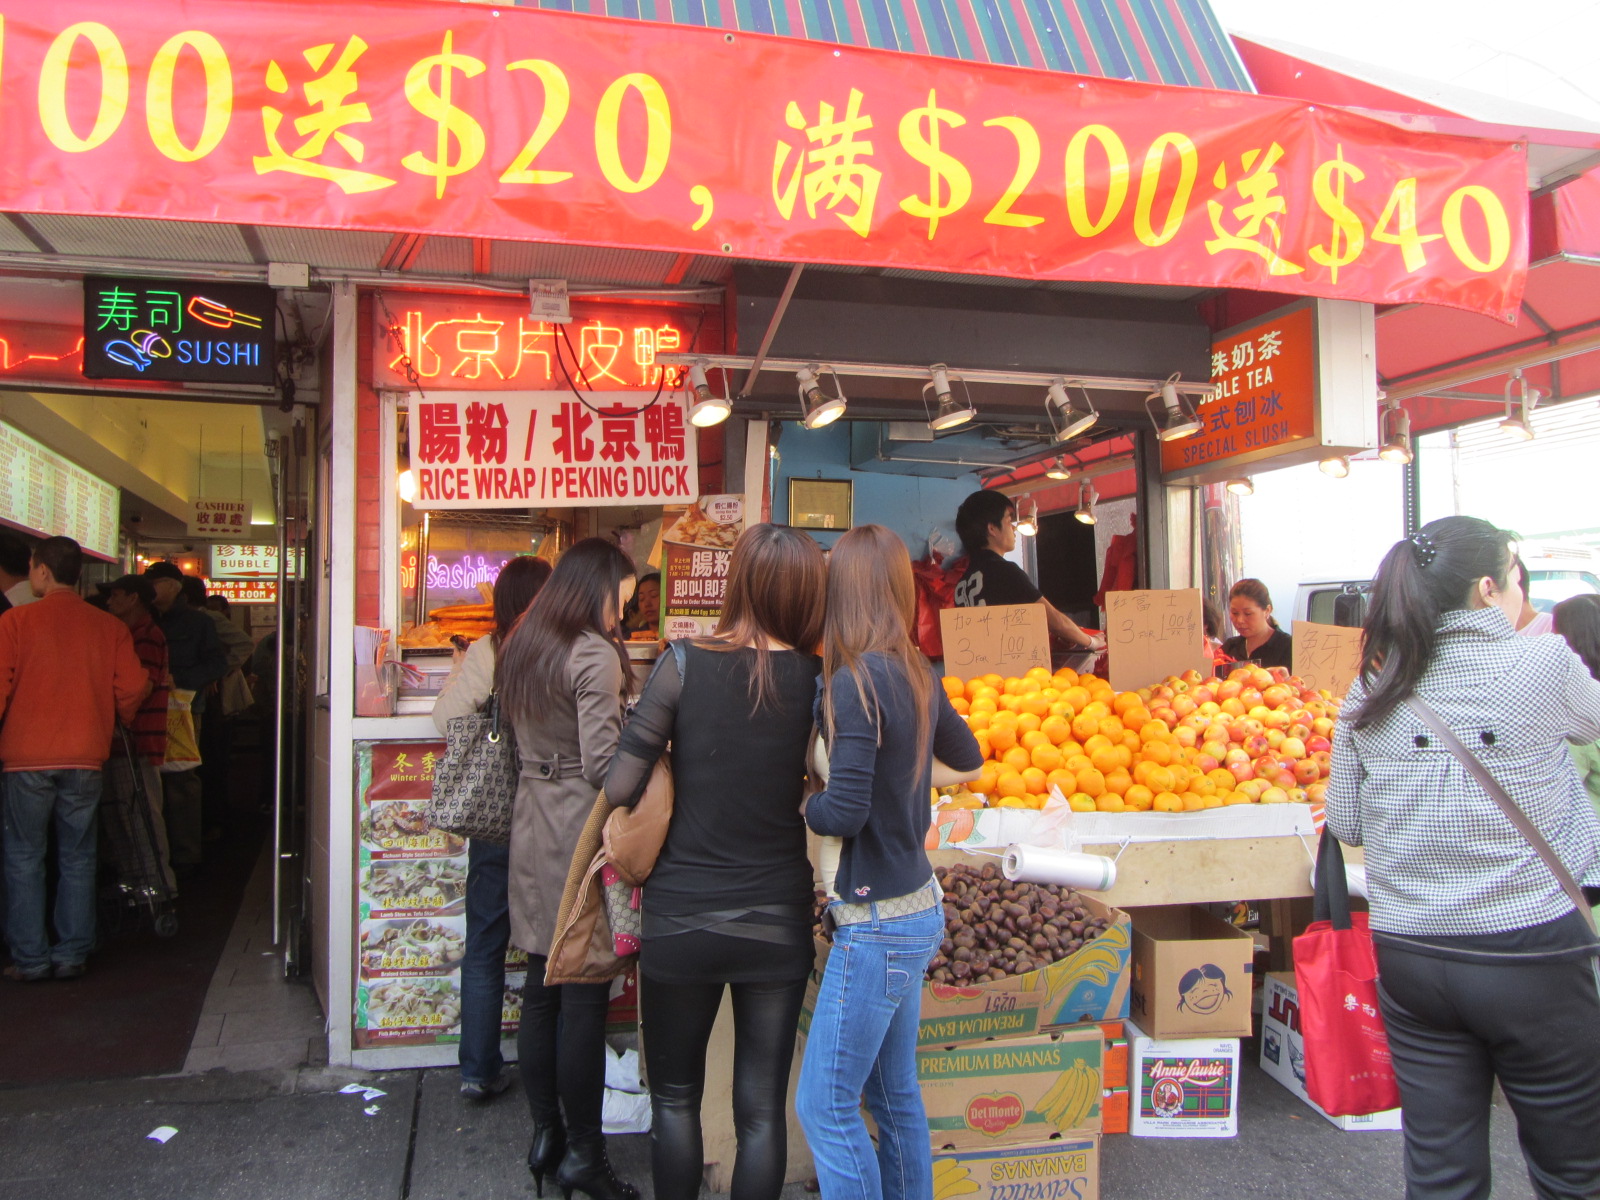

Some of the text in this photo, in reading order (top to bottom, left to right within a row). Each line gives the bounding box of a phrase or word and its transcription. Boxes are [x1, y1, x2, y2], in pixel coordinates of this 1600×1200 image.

[97, 286, 183, 334] 寿司
[177, 339, 260, 367] SUSHI
[1211, 330, 1283, 378] 珠奶茶
[1246, 365, 1274, 390] TEA
[418, 402, 509, 465] 腸粉
[552, 402, 686, 464] 北京鴨
[1183, 420, 1289, 464] SPECIAL SLUSH
[420, 468, 469, 501] RICE
[473, 468, 537, 501] WRAP
[551, 466, 629, 499] PEKING
[633, 465, 690, 497] DUCK
[195, 501, 245, 512] CASHIER
[196, 512, 243, 526] 收銀處
[220, 559, 270, 569] BUBBLE
[426, 555, 508, 589] Sashim
[690, 551, 733, 578] 腸粉
[208, 590, 236, 600] NING
[239, 590, 267, 599] ROOM
[954, 571, 986, 608] 92
[1115, 619, 1136, 644] 3
[954, 637, 975, 666] 3
[392, 752, 436, 774] 冬季
[390, 773, 435, 782] Winter Sea
[1233, 901, 1248, 926] 2
[918, 1013, 1025, 1041] PREMIUM BANA
[920, 1048, 1061, 1074] PREMIUM BANANAS
[1149, 1058, 1225, 1087] Annie Laurie
[970, 1105, 1020, 1119] Del Monte
[990, 1153, 1087, 1182] BANANAS
[990, 1176, 1088, 1200] Selvatica
